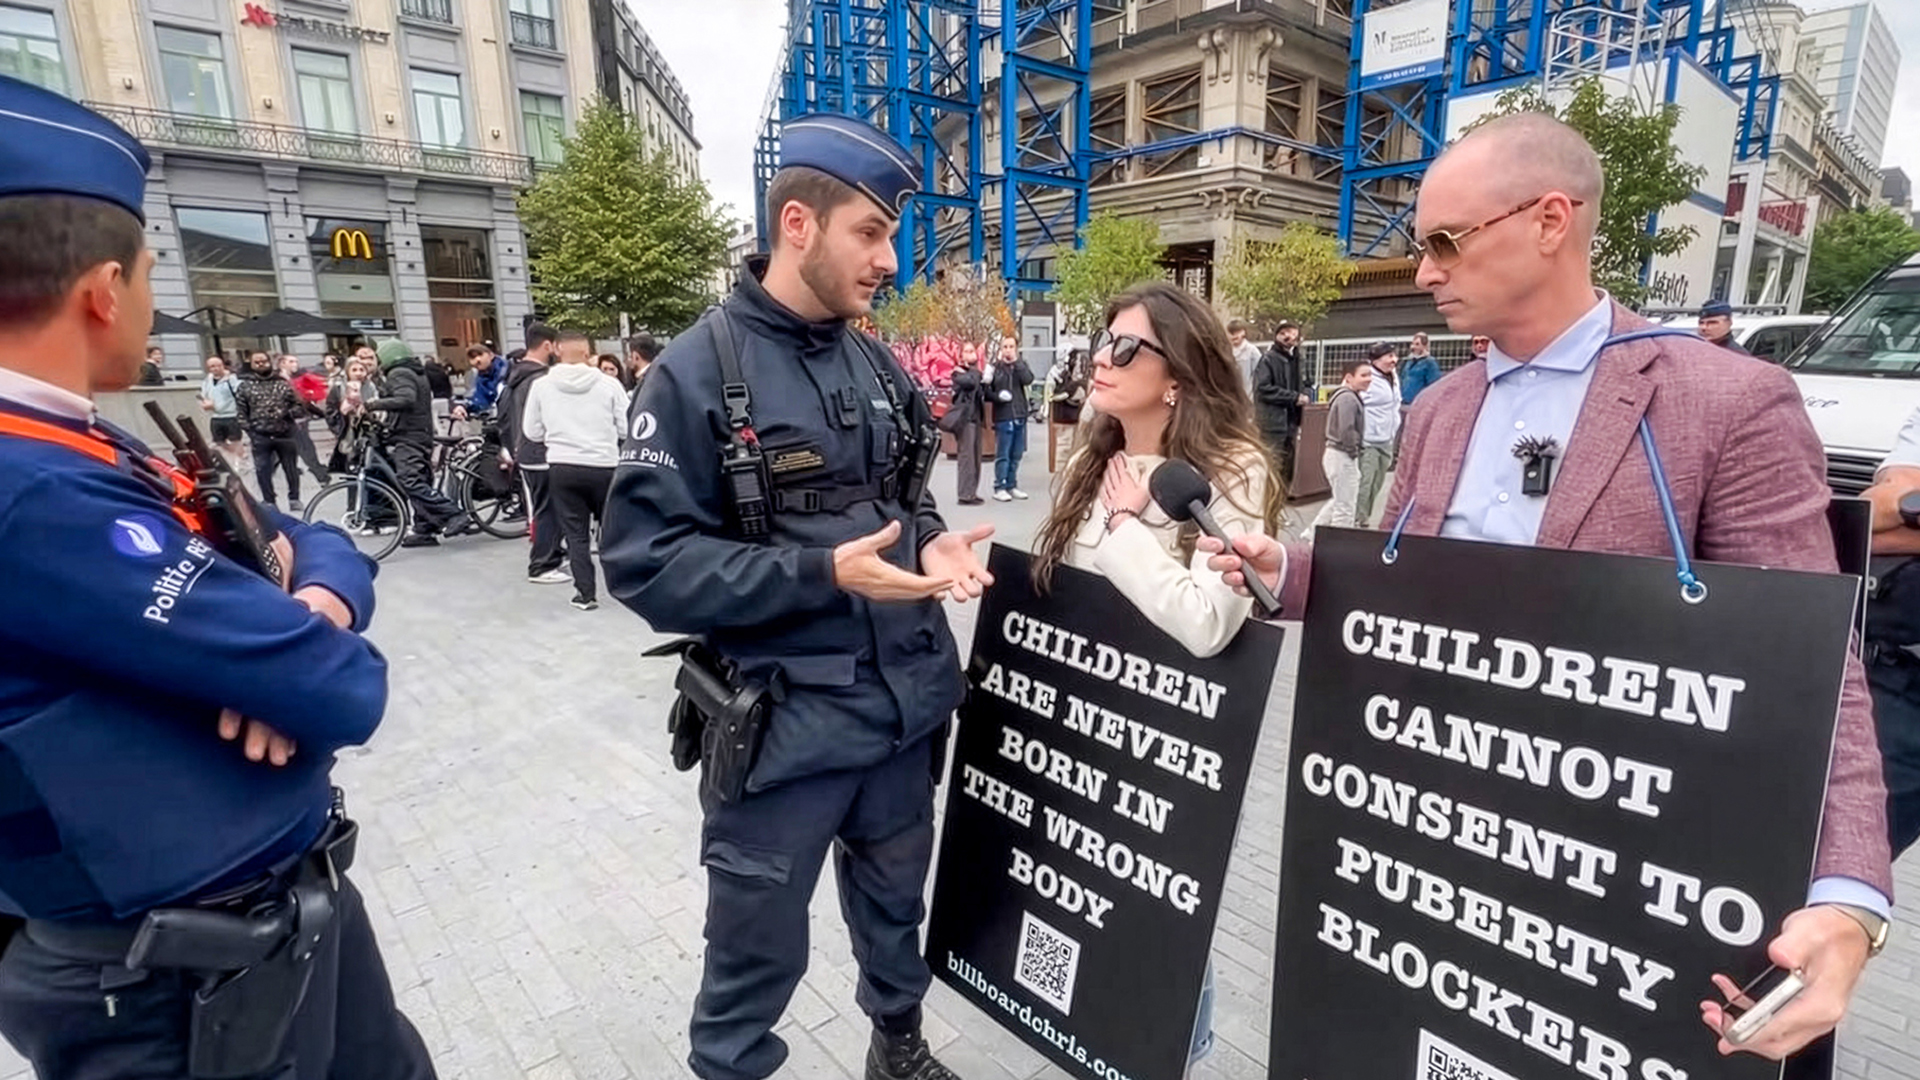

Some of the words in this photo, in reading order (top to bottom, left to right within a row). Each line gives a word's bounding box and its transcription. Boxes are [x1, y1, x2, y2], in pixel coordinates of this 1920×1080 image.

[980, 663, 1058, 719] ARE
[1063, 695, 1223, 791] NEVER
[1003, 611, 1227, 720] CHILDREN
[1342, 609, 1746, 732] CHILDREN
[998, 726, 1108, 803] BORN
[1112, 780, 1174, 834] IN
[1364, 694, 1673, 818] CANNOT
[964, 764, 1034, 828] THE
[1043, 806, 1201, 916] WRONG
[1008, 847, 1114, 929] BODY
[1302, 752, 1617, 899] CONSENT
[1639, 861, 1764, 947] TO
[1334, 837, 1676, 1012] PUBERTY
[947, 951, 1132, 1080] billboardchris.co
